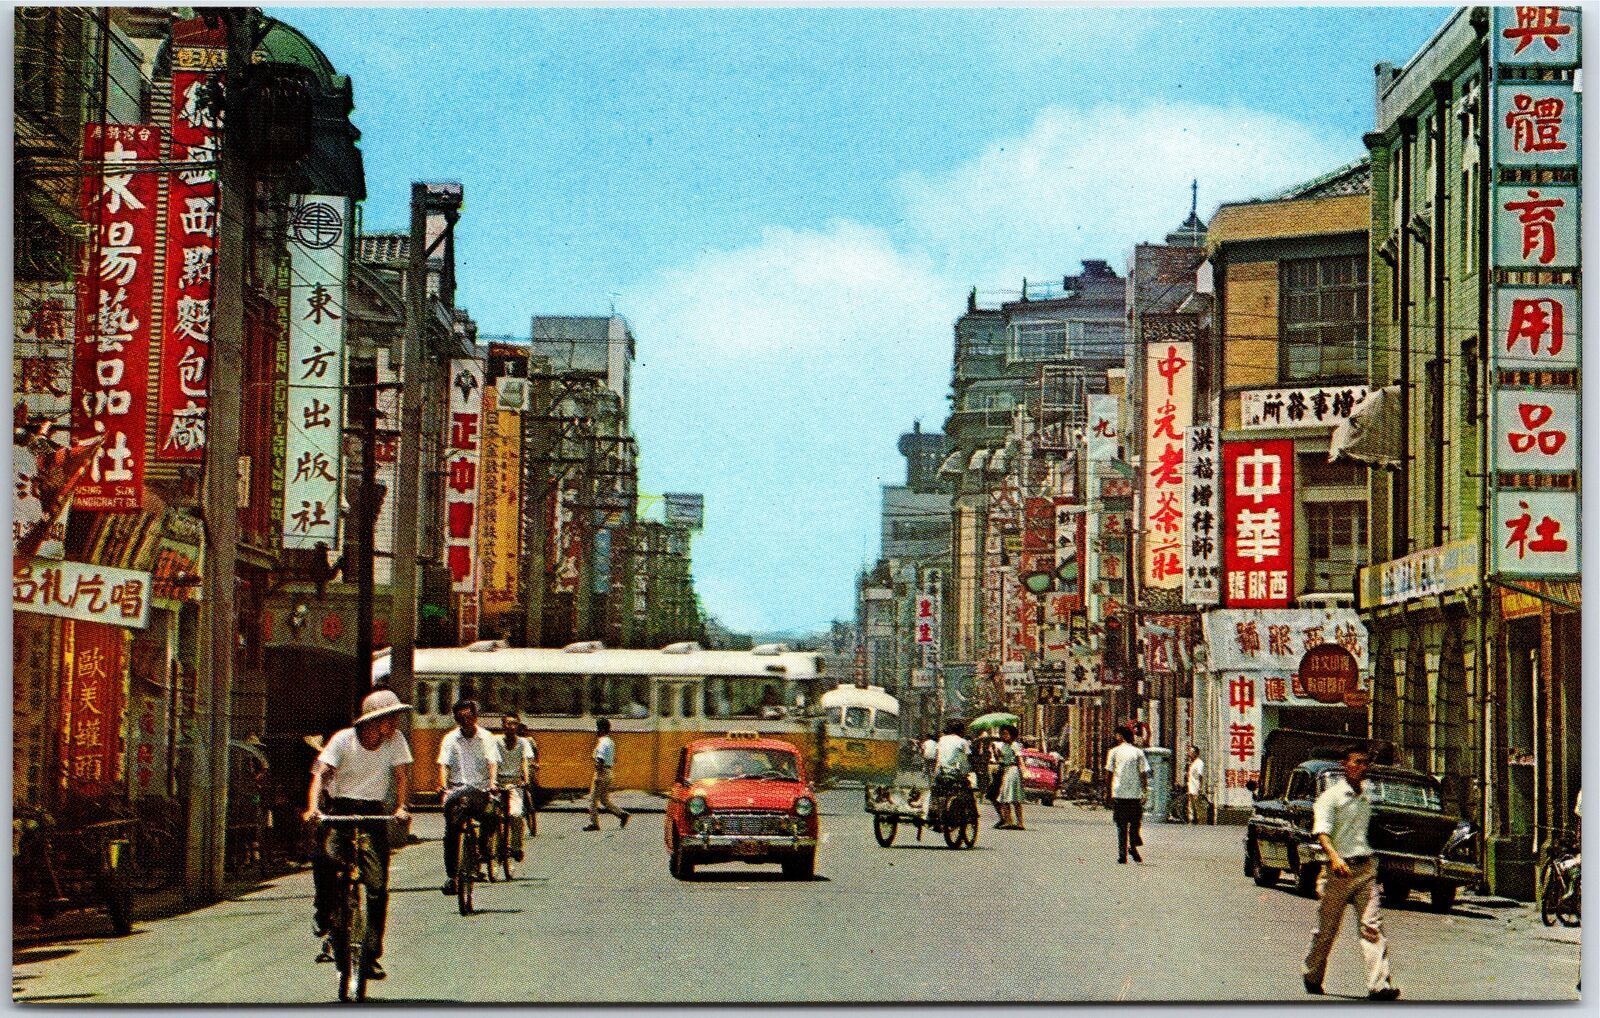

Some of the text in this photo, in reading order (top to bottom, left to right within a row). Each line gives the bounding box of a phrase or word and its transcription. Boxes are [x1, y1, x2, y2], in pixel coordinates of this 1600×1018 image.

[291, 282, 341, 533] 東方出版社
[1150, 345, 1187, 581] 中光老茶莊
[77, 497, 124, 507] ANDICRAFT
[1236, 448, 1281, 563] 中華
[1229, 675, 1255, 762] 中華
